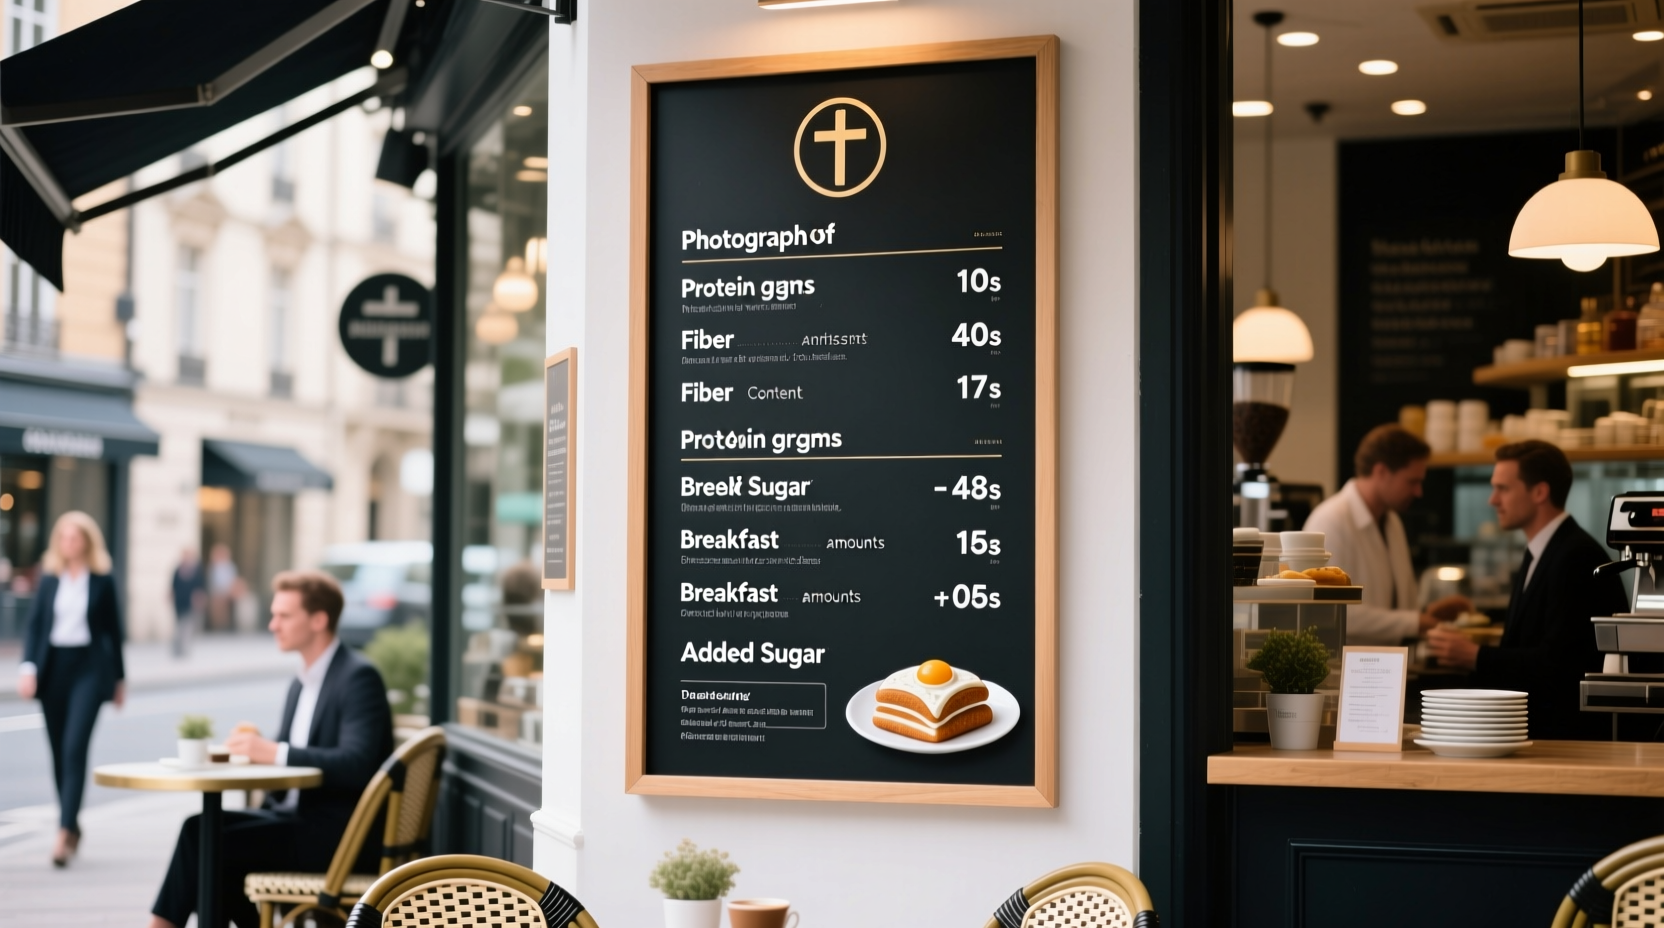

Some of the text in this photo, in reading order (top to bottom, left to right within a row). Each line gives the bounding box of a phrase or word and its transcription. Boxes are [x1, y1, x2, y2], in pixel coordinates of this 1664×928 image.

[682, 224, 807, 253] Photograph
[681, 275, 756, 299] Protein
[956, 267, 1002, 293] 10s
[681, 328, 735, 350] Fiber
[951, 321, 1002, 347] 40s
[681, 381, 804, 402] Fiber Content
[956, 374, 1002, 400] 17s
[747, 475, 811, 502] Sugar
[680, 528, 885, 550] Breakfast amounts
[680, 581, 862, 604] Breakfast amounts
[680, 640, 826, 670] Added Sugar
